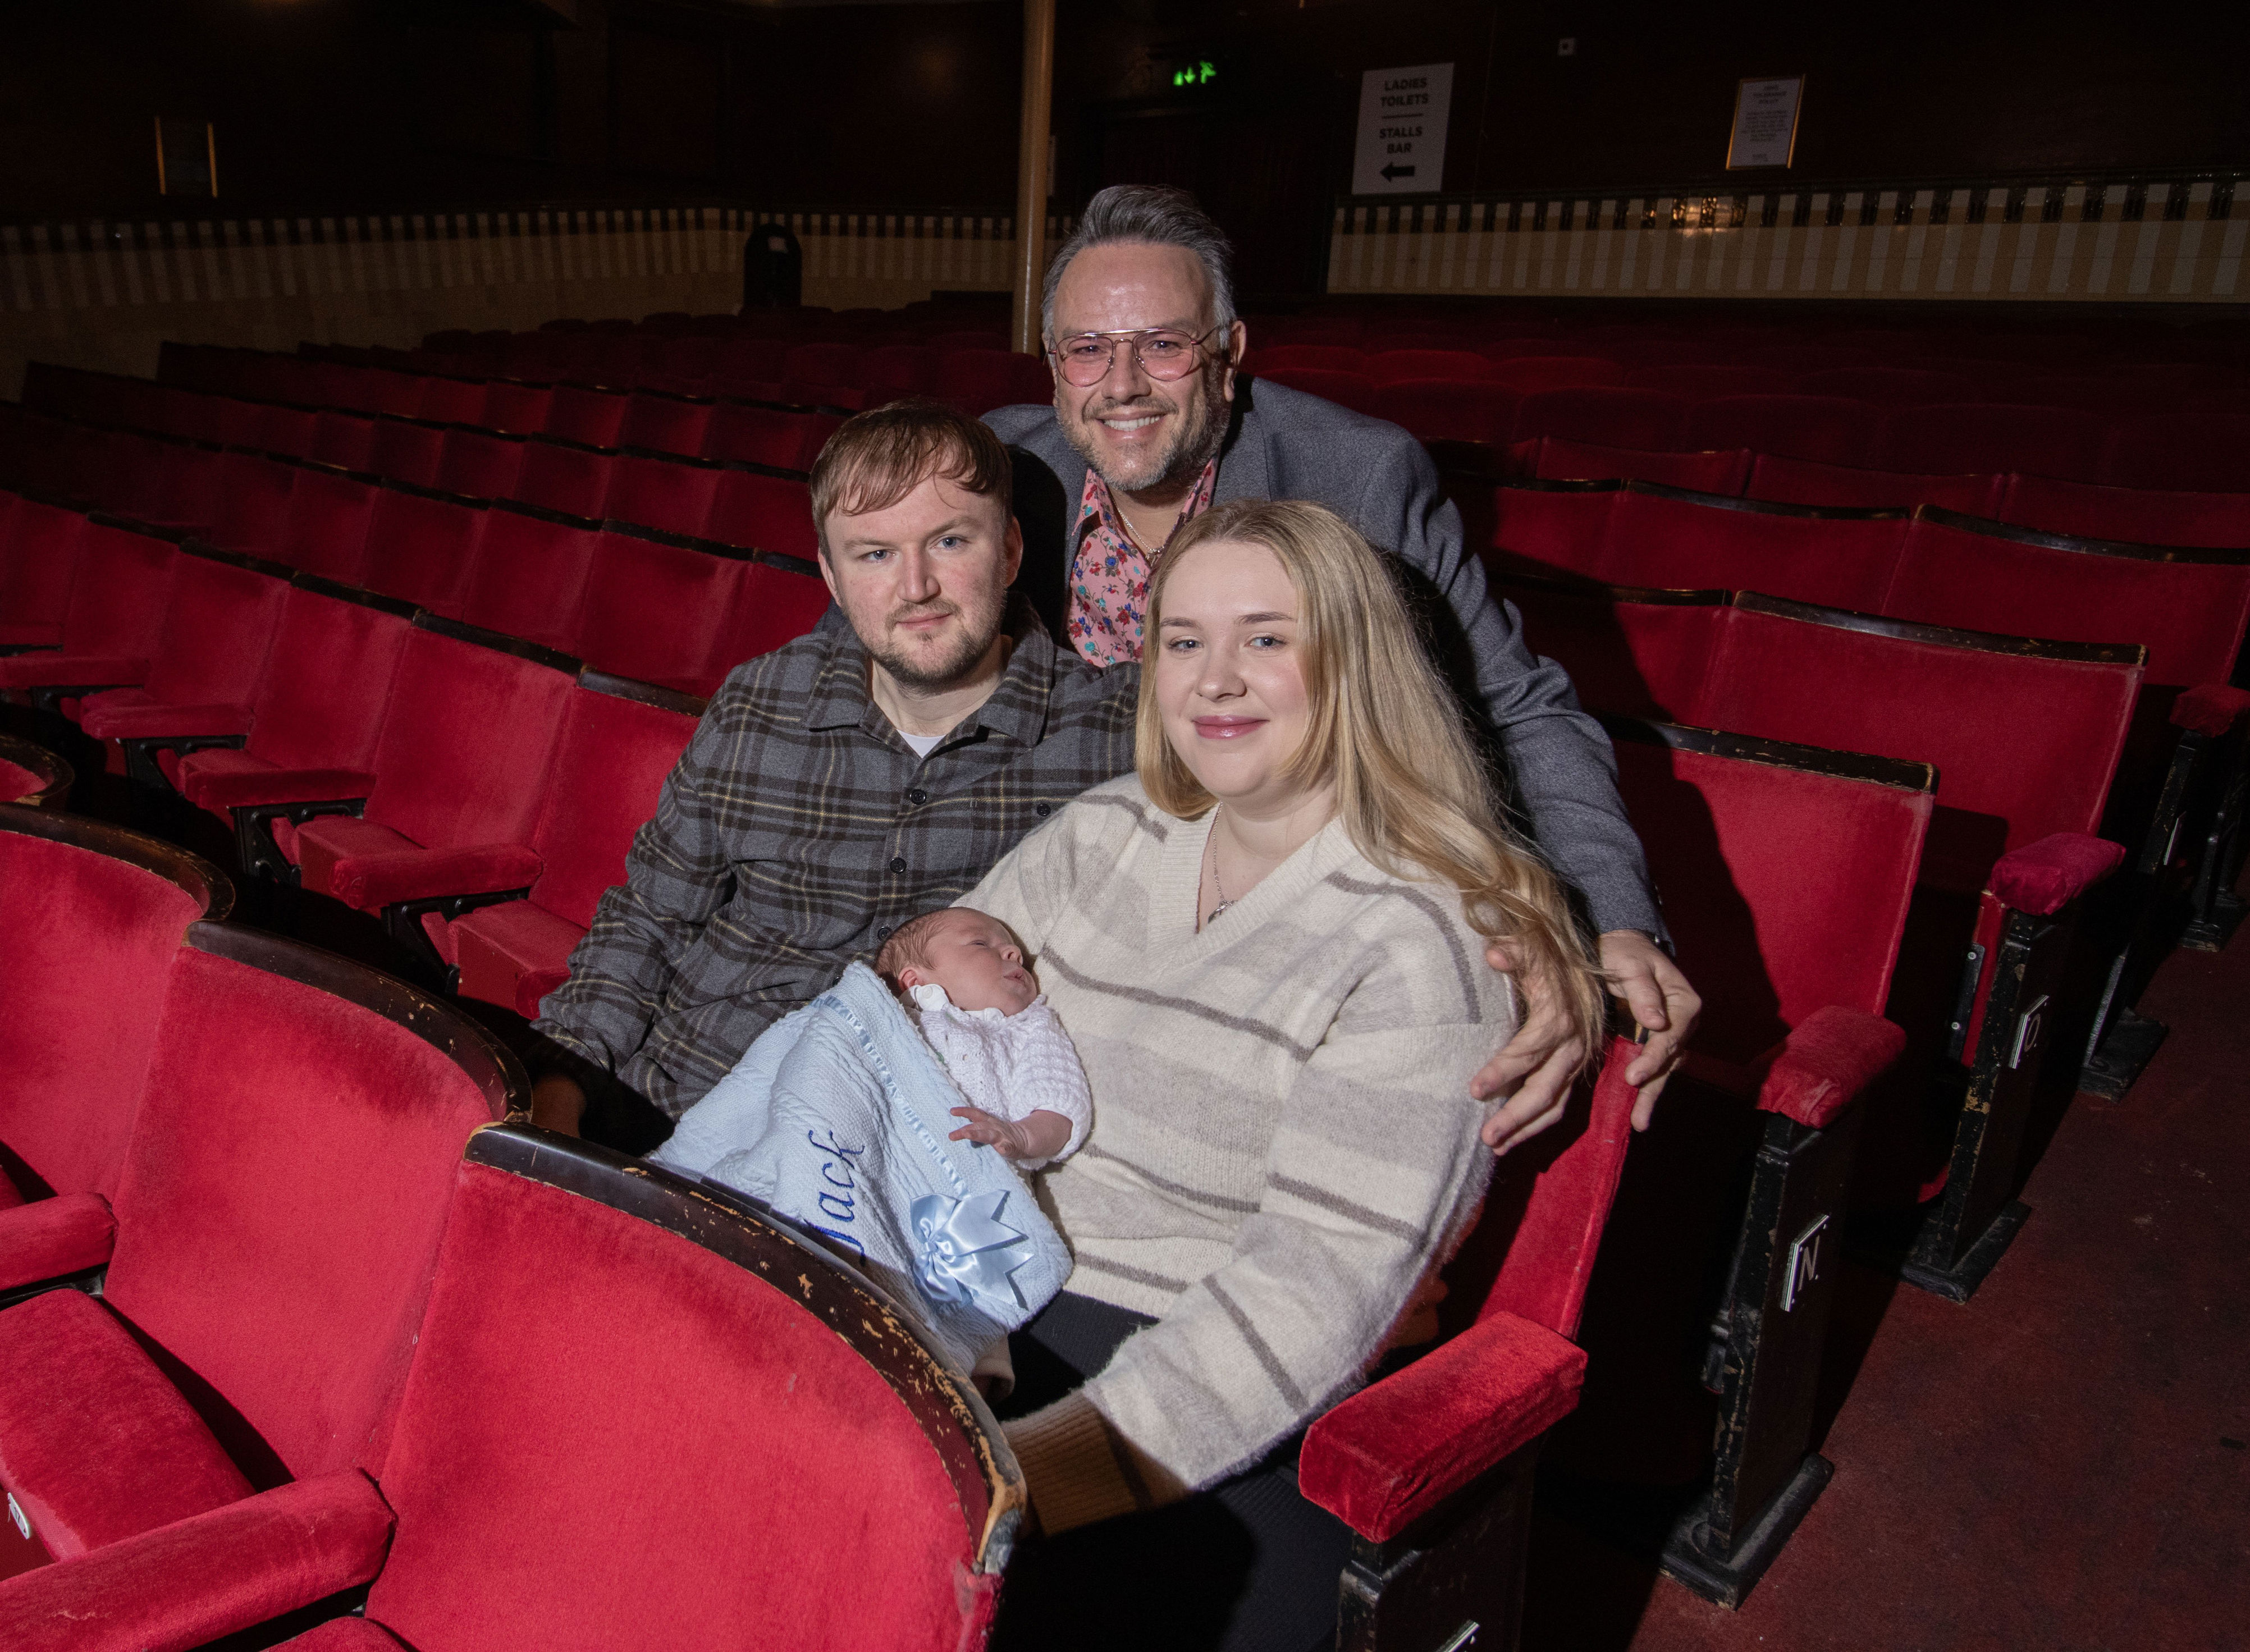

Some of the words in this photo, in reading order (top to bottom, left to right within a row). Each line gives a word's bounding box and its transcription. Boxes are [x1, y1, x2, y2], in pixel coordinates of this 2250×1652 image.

[1384, 77, 1428, 91] LADIES
[1380, 93, 1429, 107] TOILETS
[1379, 126, 1423, 139] STALLS
[1387, 143, 1412, 154] BAR
[808, 1129, 866, 1266] Jack
[1798, 1234, 1820, 1292] N
